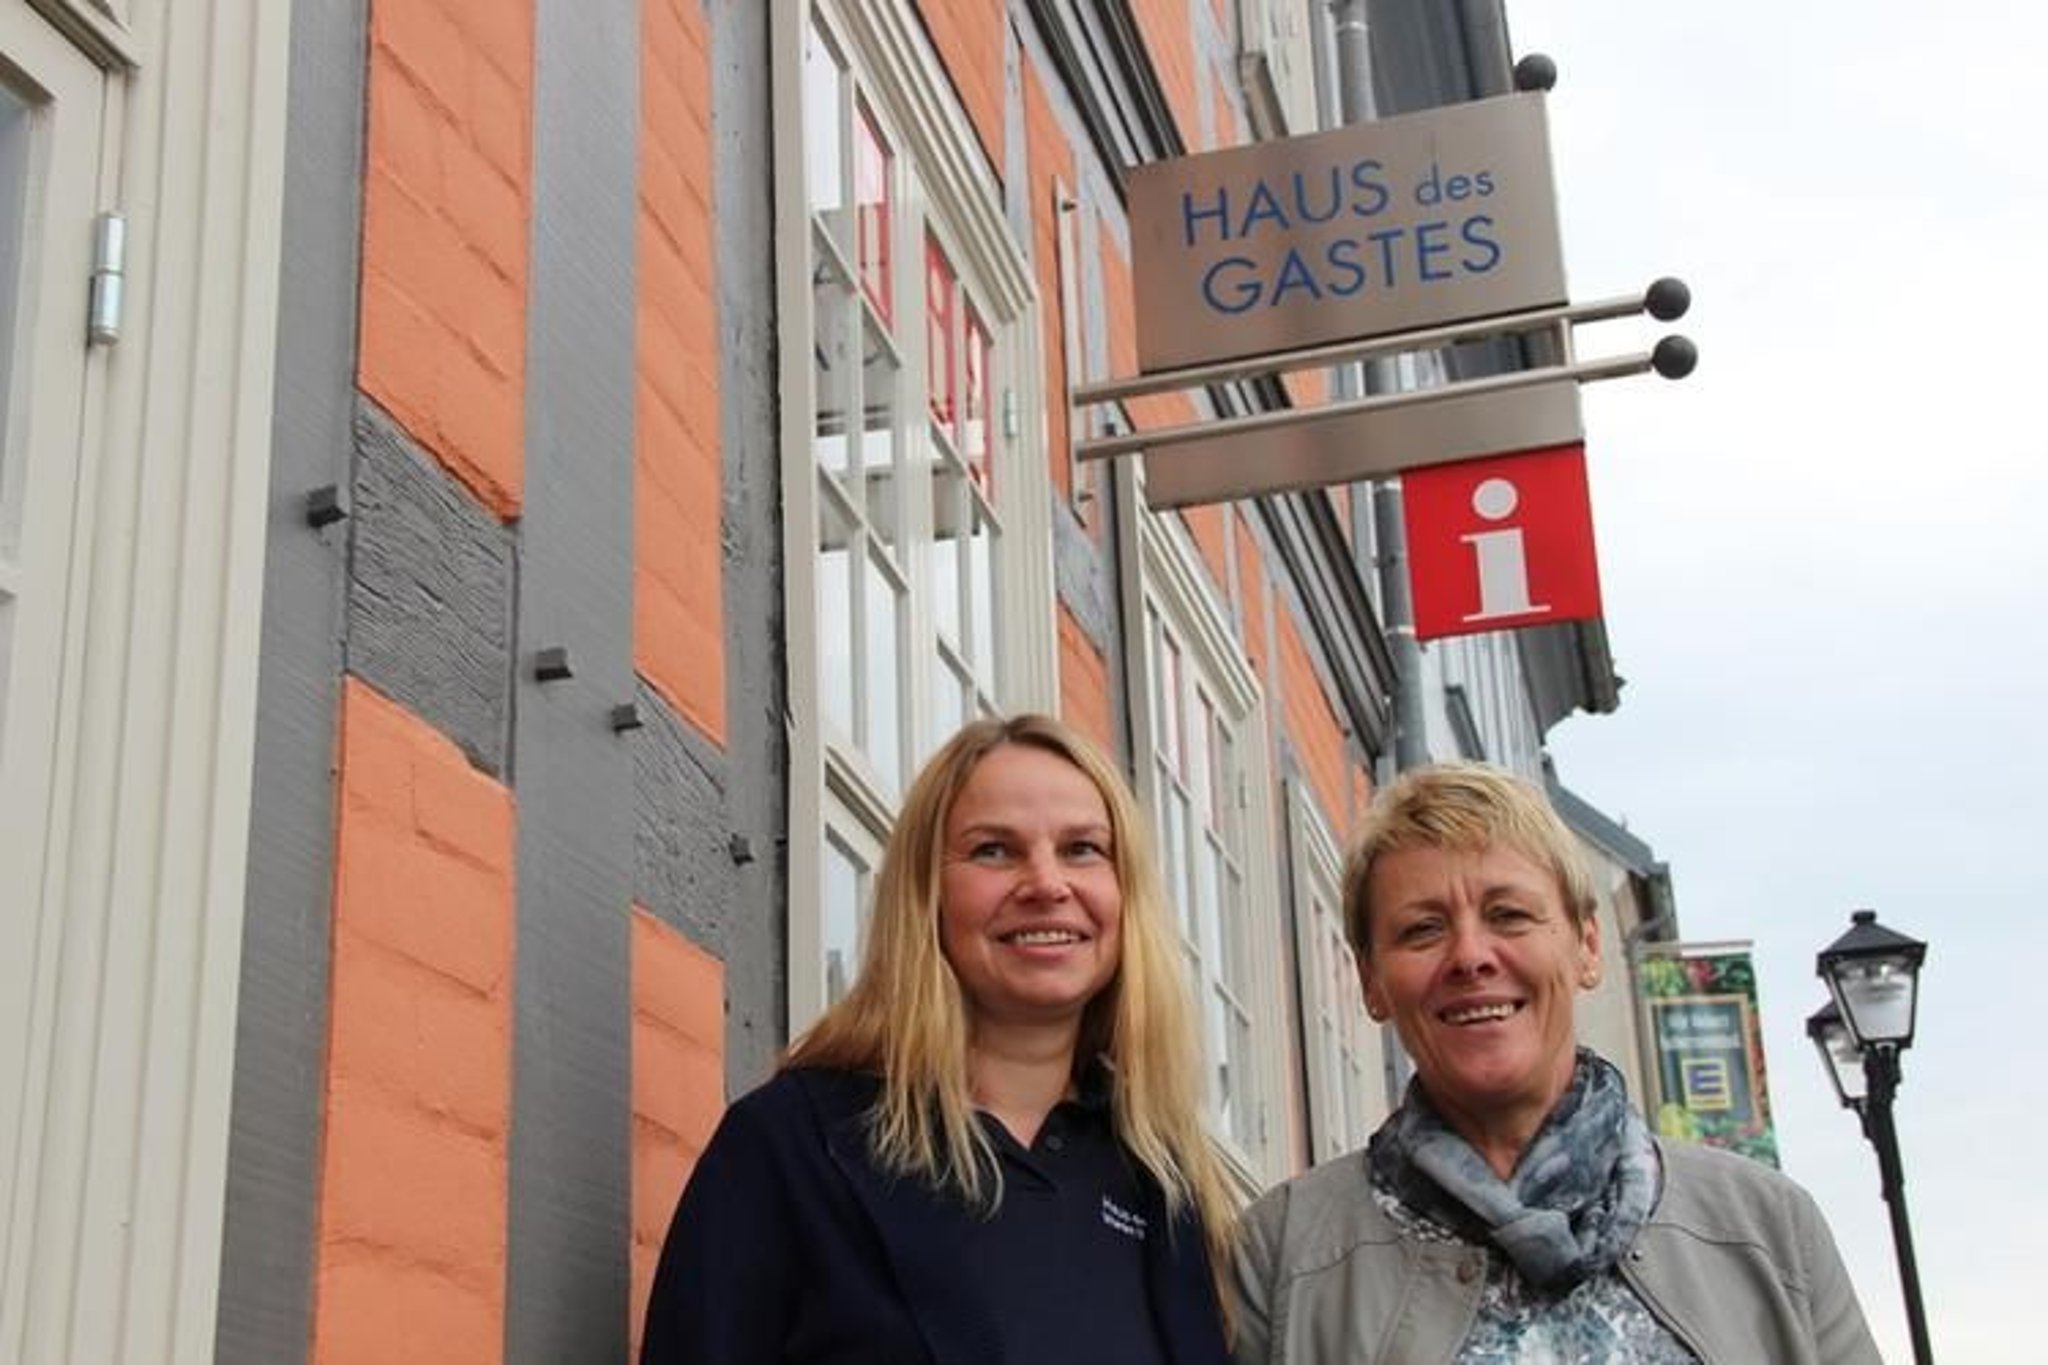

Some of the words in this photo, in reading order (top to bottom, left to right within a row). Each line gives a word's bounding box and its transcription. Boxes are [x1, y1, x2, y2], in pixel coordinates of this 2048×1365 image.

[1182, 160, 1389, 247] HAUS
[1415, 163, 1495, 207] des
[1202, 215, 1501, 315] GASTES
[1460, 478, 1552, 623] i
[1687, 1063, 1723, 1095] E
